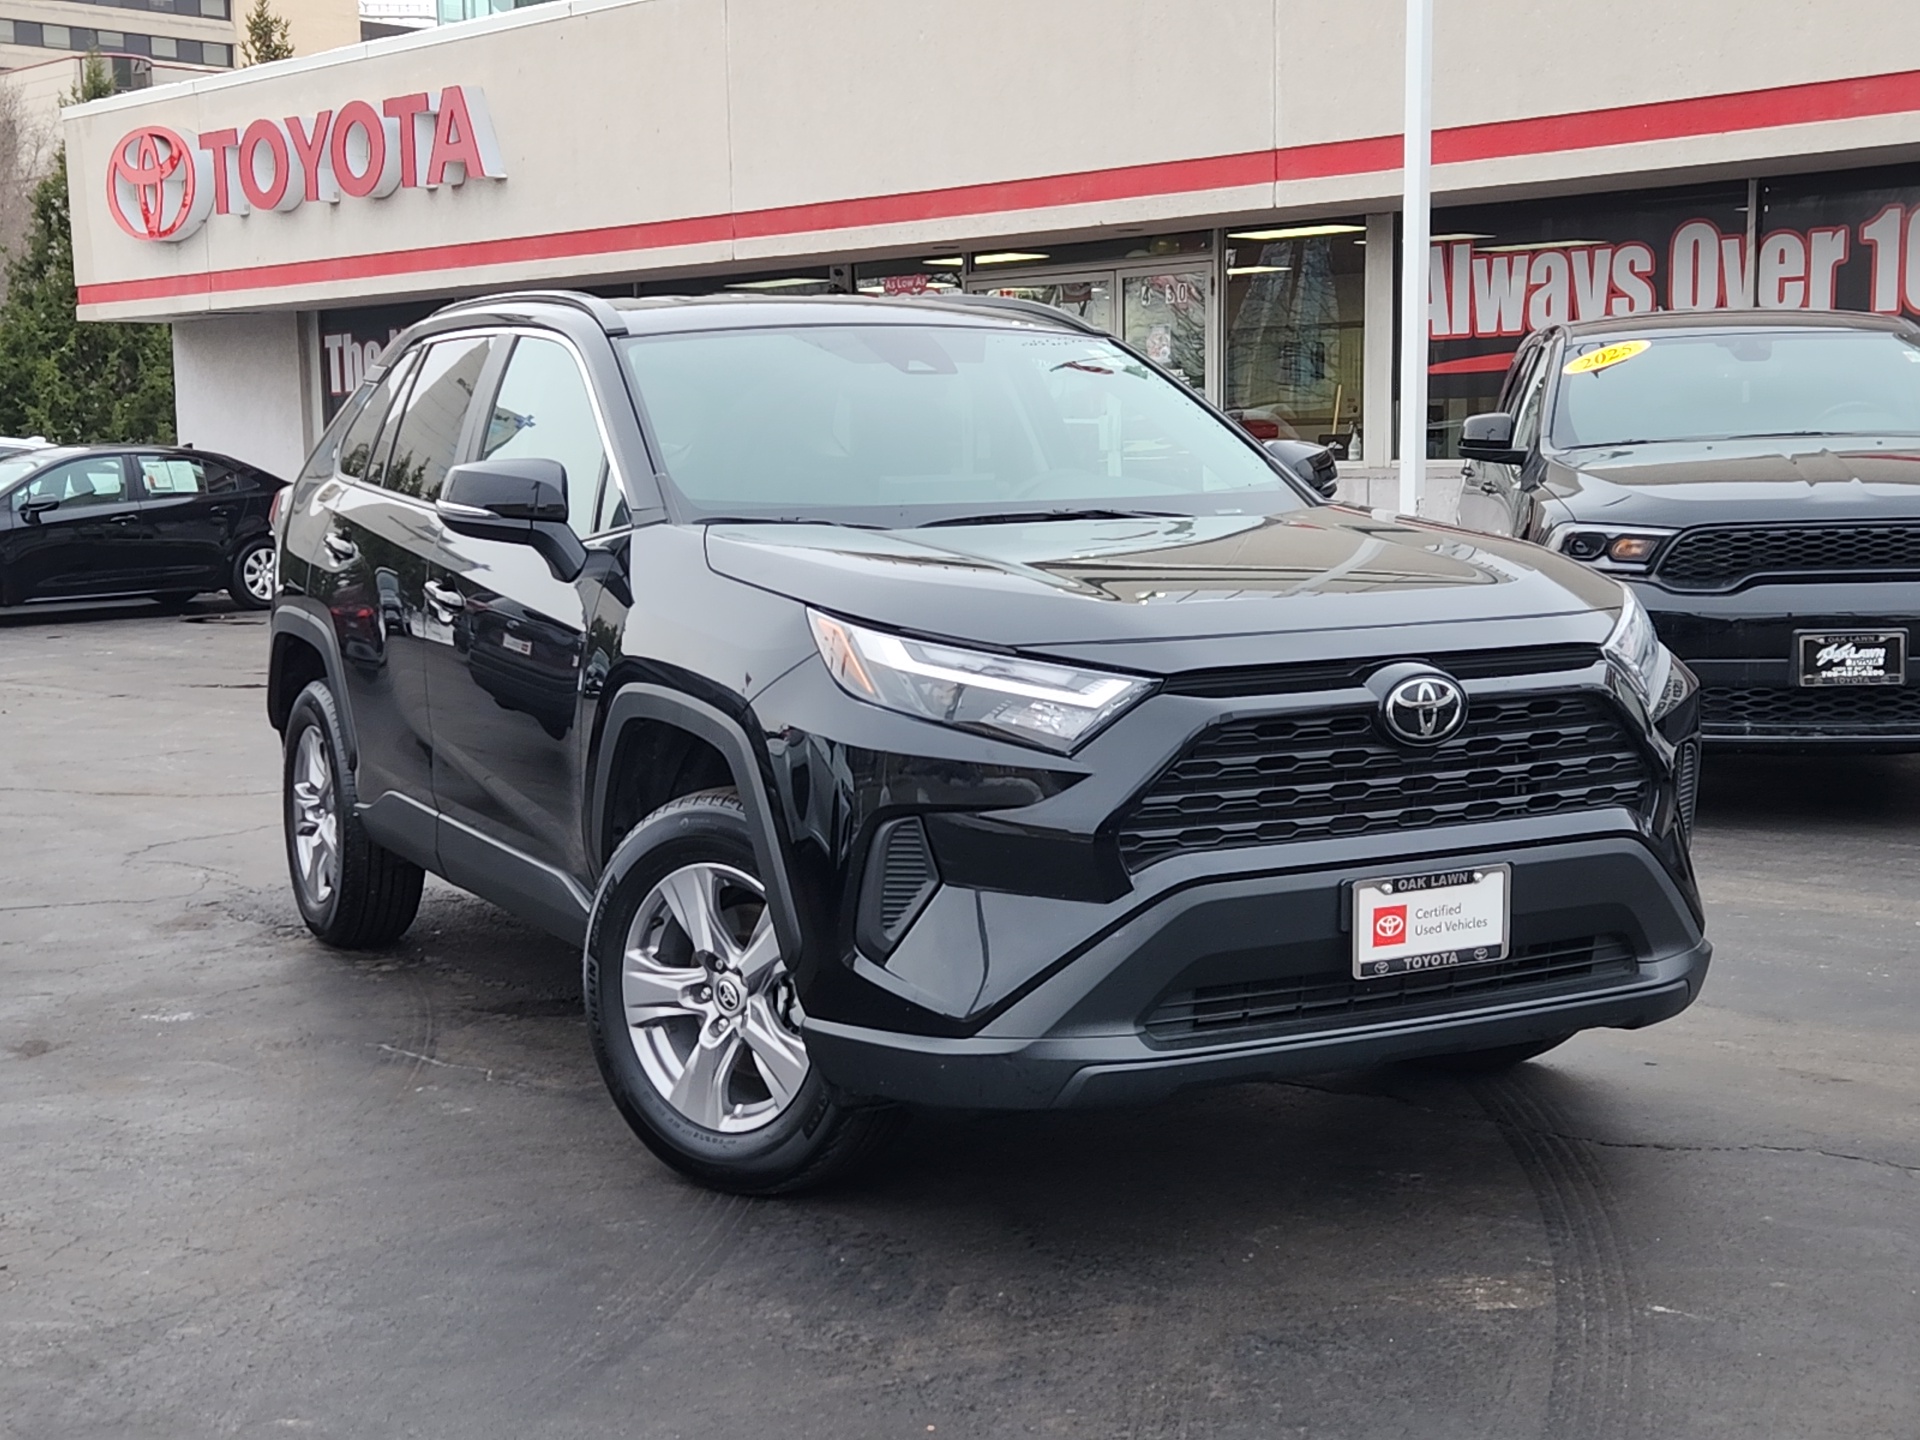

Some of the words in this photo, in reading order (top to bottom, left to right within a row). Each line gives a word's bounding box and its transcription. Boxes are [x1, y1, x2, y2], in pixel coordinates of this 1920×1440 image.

[199, 84, 500, 215] TOYOTA
[1669, 218, 1849, 310] Over
[1583, 343, 1632, 369] 2025
[1398, 877, 1427, 891] OAK
[1431, 872, 1468, 887] LAWN
[1415, 902, 1462, 919] Certified
[1415, 921, 1443, 936] Used
[1445, 917, 1488, 932] Vehicles
[1403, 951, 1459, 971] TOYOTA
